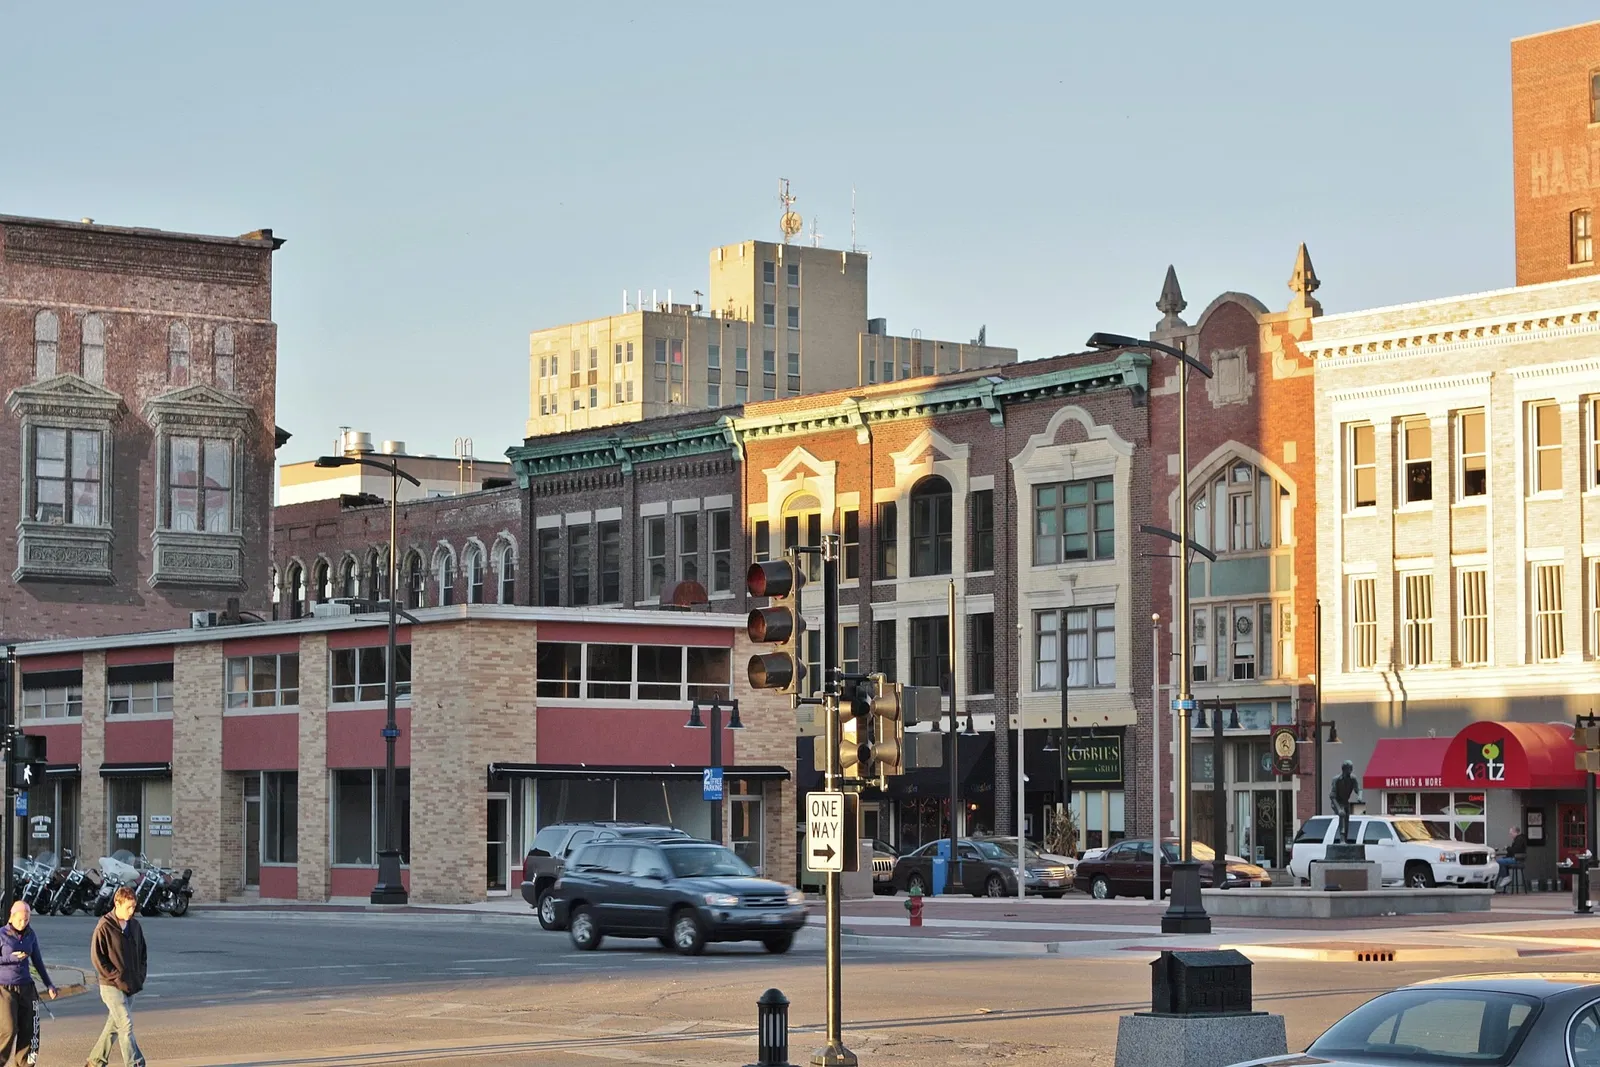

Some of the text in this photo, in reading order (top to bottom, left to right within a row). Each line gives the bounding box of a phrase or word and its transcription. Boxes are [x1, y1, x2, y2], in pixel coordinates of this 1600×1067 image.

[1418, 778, 1423, 787] &
[1425, 777, 1442, 787] MORE
[812, 800, 838, 817] ONE
[811, 821, 839, 839] WAY
